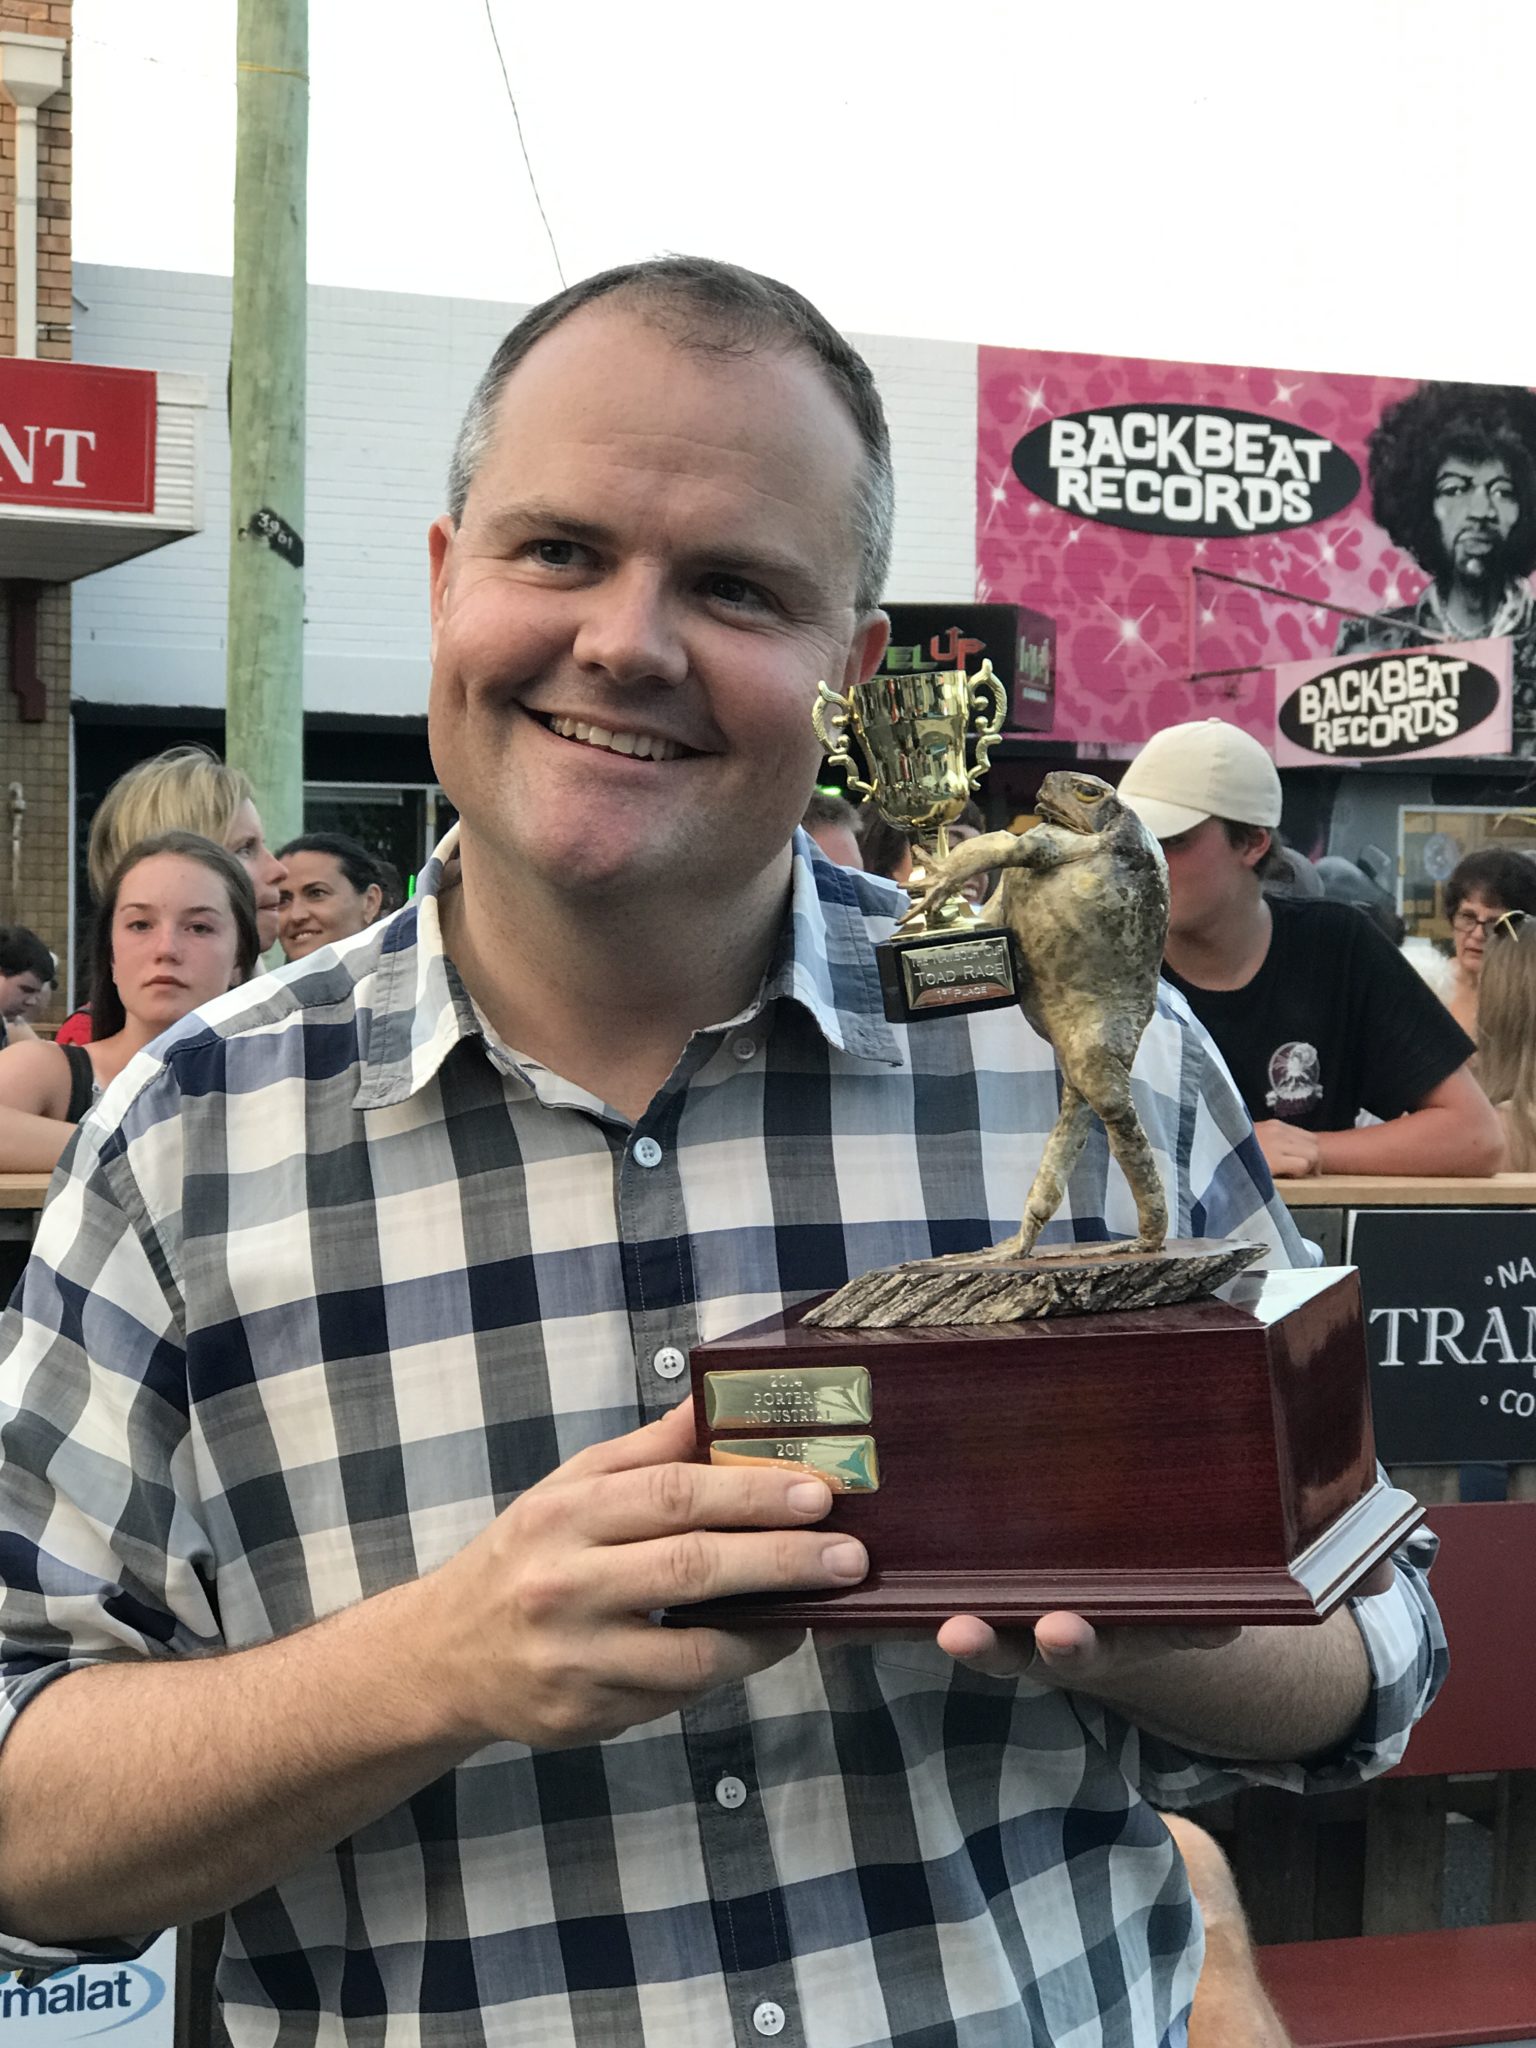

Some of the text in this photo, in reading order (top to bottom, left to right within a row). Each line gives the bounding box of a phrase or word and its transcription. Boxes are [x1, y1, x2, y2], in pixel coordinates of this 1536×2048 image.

[0, 423, 97, 489] NT
[1049, 411, 1333, 484] BACKBEAT
[1056, 466, 1314, 531] RECORDS
[929, 626, 987, 671] UP
[1299, 655, 1469, 725] BACKBEAT
[1313, 697, 1459, 754] RECORDS
[913, 963, 1005, 987] TOAD RACE
[953, 986, 988, 998] PLACE
[744, 1408, 833, 1424] INDUSTRIAL
[776, 1442, 809, 1457] 2015
[0, 1970, 132, 2019] malat
